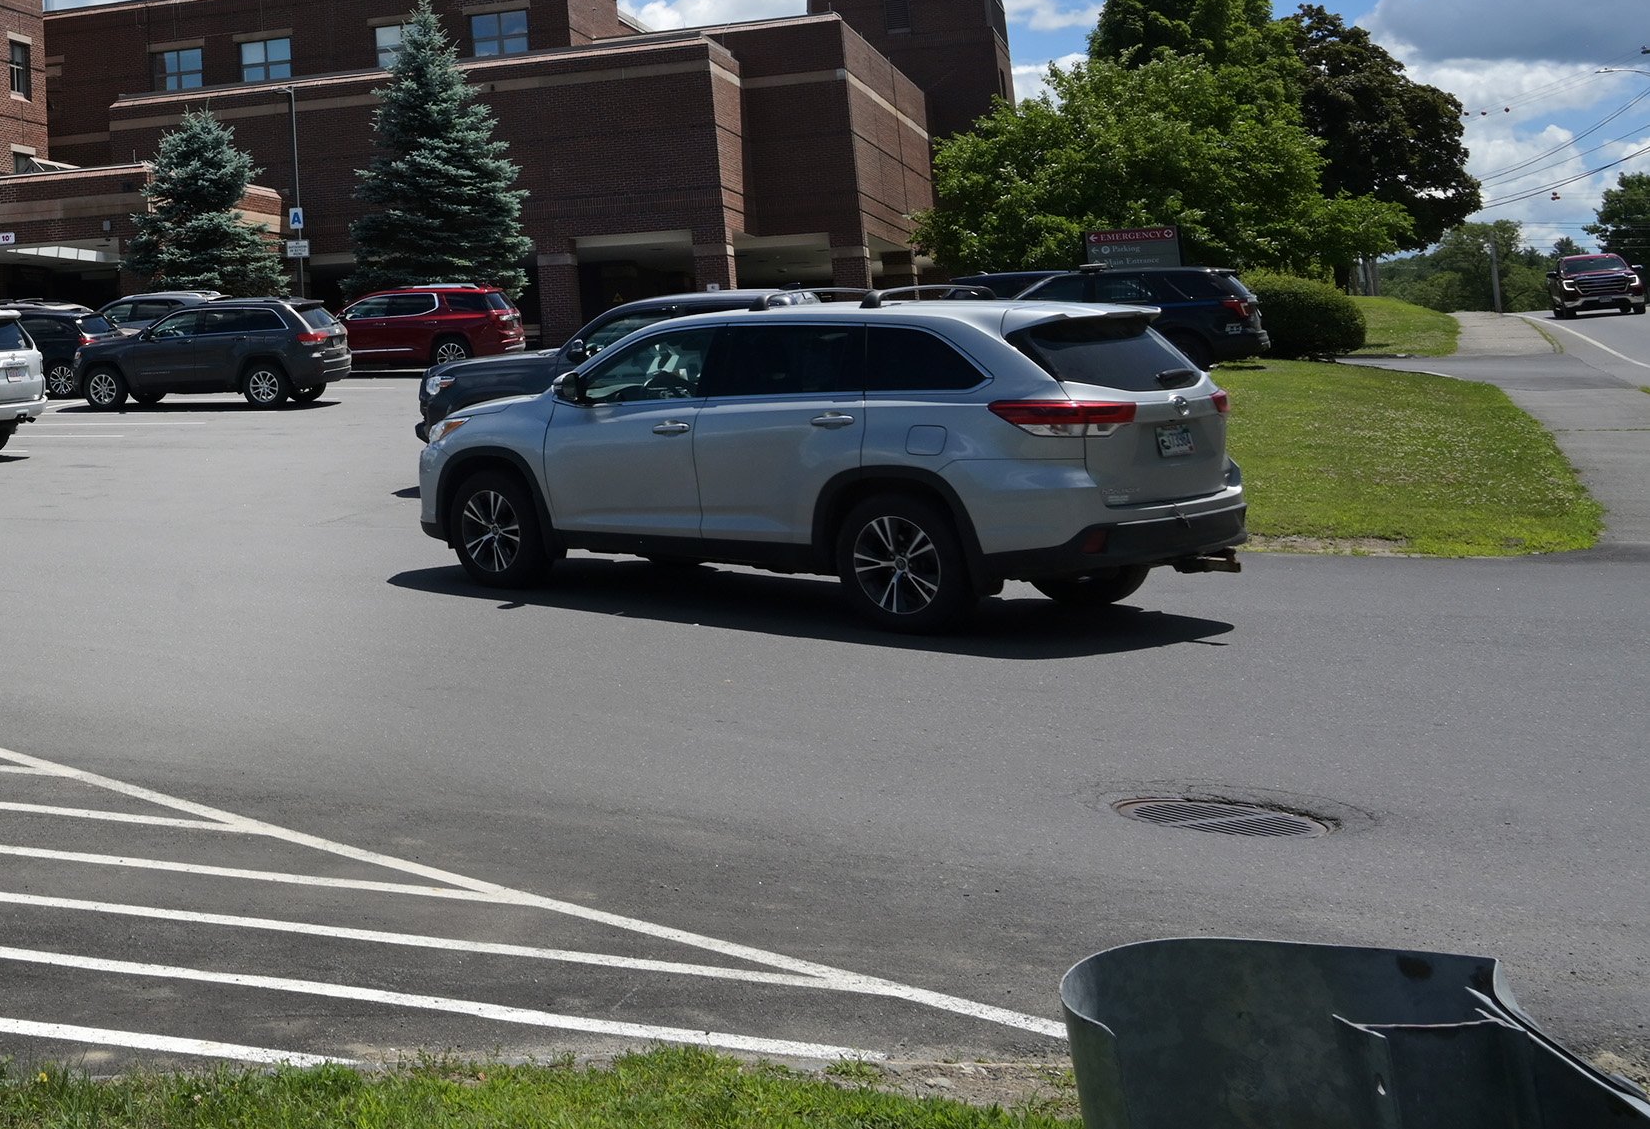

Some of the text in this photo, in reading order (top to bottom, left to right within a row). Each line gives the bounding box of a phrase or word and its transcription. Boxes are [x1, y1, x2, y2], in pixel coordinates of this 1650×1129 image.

[291, 212, 301, 224] A
[1100, 230, 1162, 241] EMERGENCY
[1112, 245, 1141, 253] Parking
[1105, 257, 1160, 266] Main Entrance
